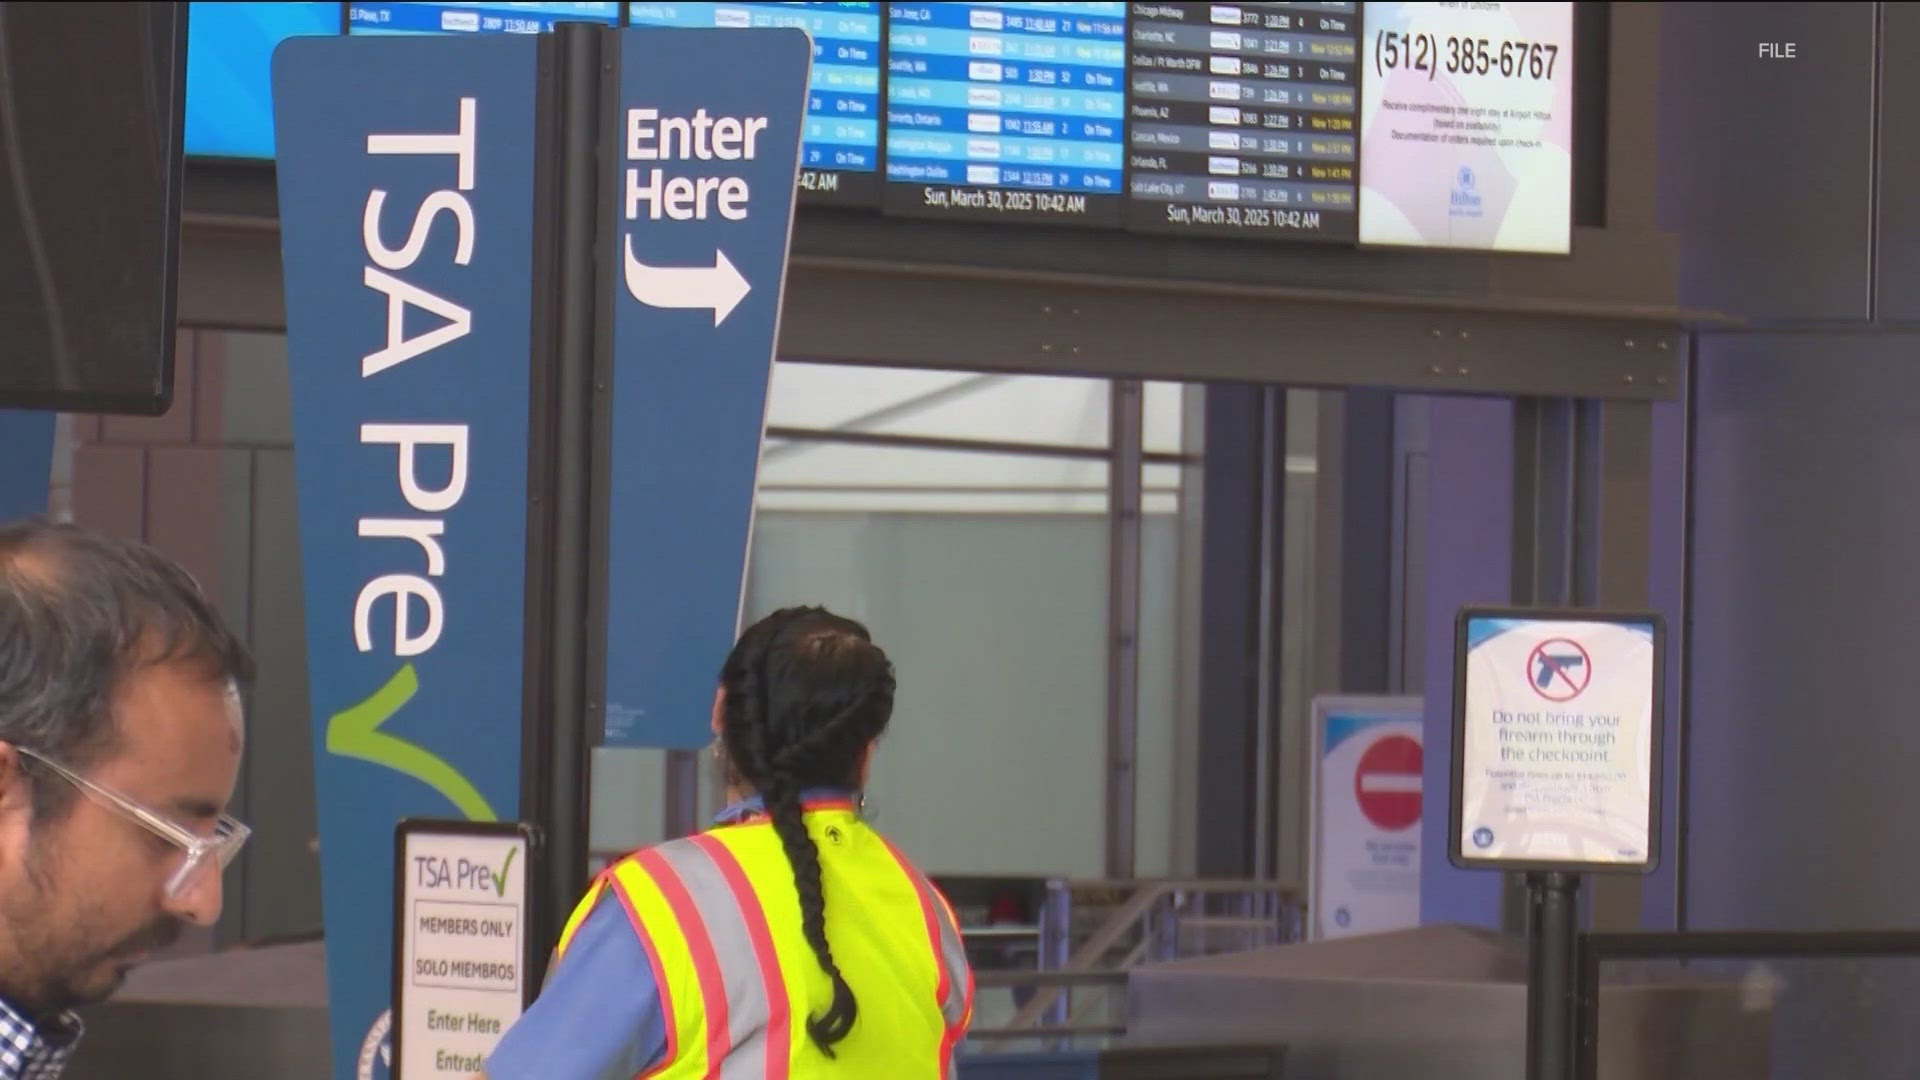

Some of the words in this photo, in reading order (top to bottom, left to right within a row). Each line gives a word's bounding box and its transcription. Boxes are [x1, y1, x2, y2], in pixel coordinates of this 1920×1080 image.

[380, 11, 391, 22] TX
[1375, 29, 1437, 81] (512)
[1446, 36, 1558, 80] 385-6767
[626, 108, 768, 161] Enter
[625, 168, 749, 221] Here
[818, 173, 838, 192] AM
[924, 187, 949, 207] Sun,
[950, 189, 985, 208] March
[986, 191, 1003, 211] 30,
[1005, 191, 1033, 210] 2025
[1035, 193, 1065, 212] 10:42
[1066, 194, 1085, 213] AM
[1167, 203, 1191, 224] Sun,
[1192, 205, 1225, 225] March
[1226, 207, 1243, 227] 30,
[1244, 208, 1270, 226] 2025
[1272, 209, 1301, 229] 10:42
[1302, 210, 1321, 230] AM
[362, 97, 476, 378] TSA
[354, 424, 468, 656] Pre
[1492, 709, 1513, 724] Do
[1517, 711, 1541, 724] not
[1545, 710, 1584, 727] bring
[1588, 715, 1621, 728] your
[1499, 727, 1553, 743] firearm
[1557, 729, 1616, 746] through
[1501, 747, 1525, 761] the
[415, 856, 451, 889] TSA
[457, 858, 490, 892] Pre
[420, 917, 478, 935] MEMBERS
[480, 921, 513, 938] ONLY
[416, 959, 448, 977] SOLO
[451, 961, 514, 981] MIEMBROS
[427, 1010, 464, 1032] Enter
[467, 1013, 501, 1034] Here
[436, 1051, 482, 1073] Entrad
